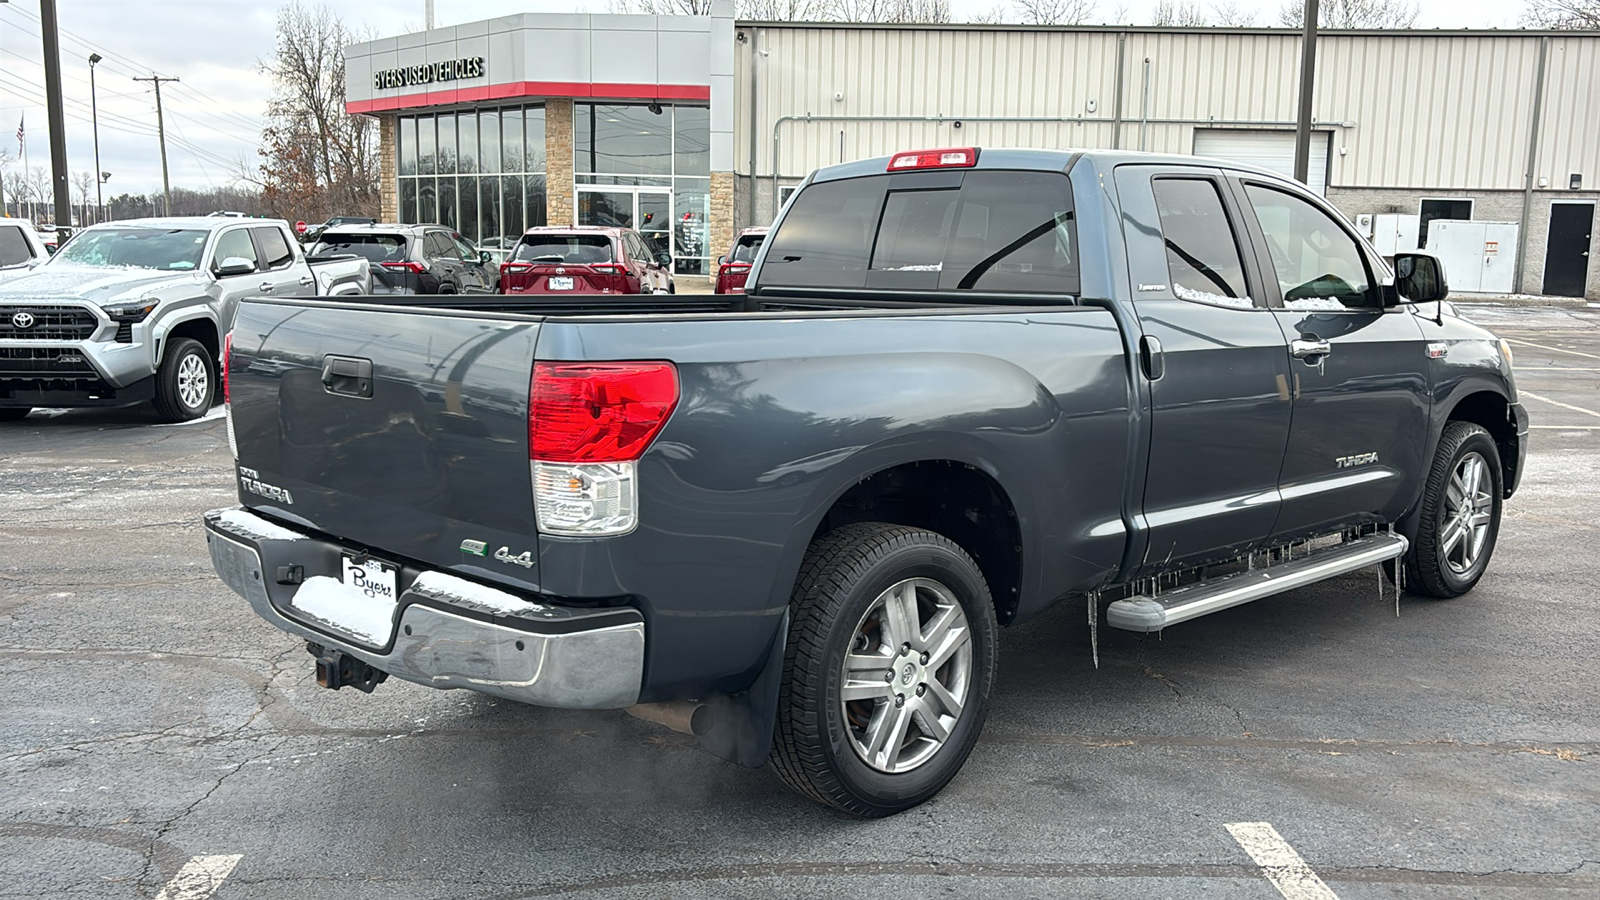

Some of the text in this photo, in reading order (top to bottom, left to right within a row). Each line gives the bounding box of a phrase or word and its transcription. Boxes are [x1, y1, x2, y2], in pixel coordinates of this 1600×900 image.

[374, 56, 483, 90] BYERS USED VEHICLES
[1336, 451, 1379, 469] TUNDRA
[241, 476, 293, 504] TUNDRA
